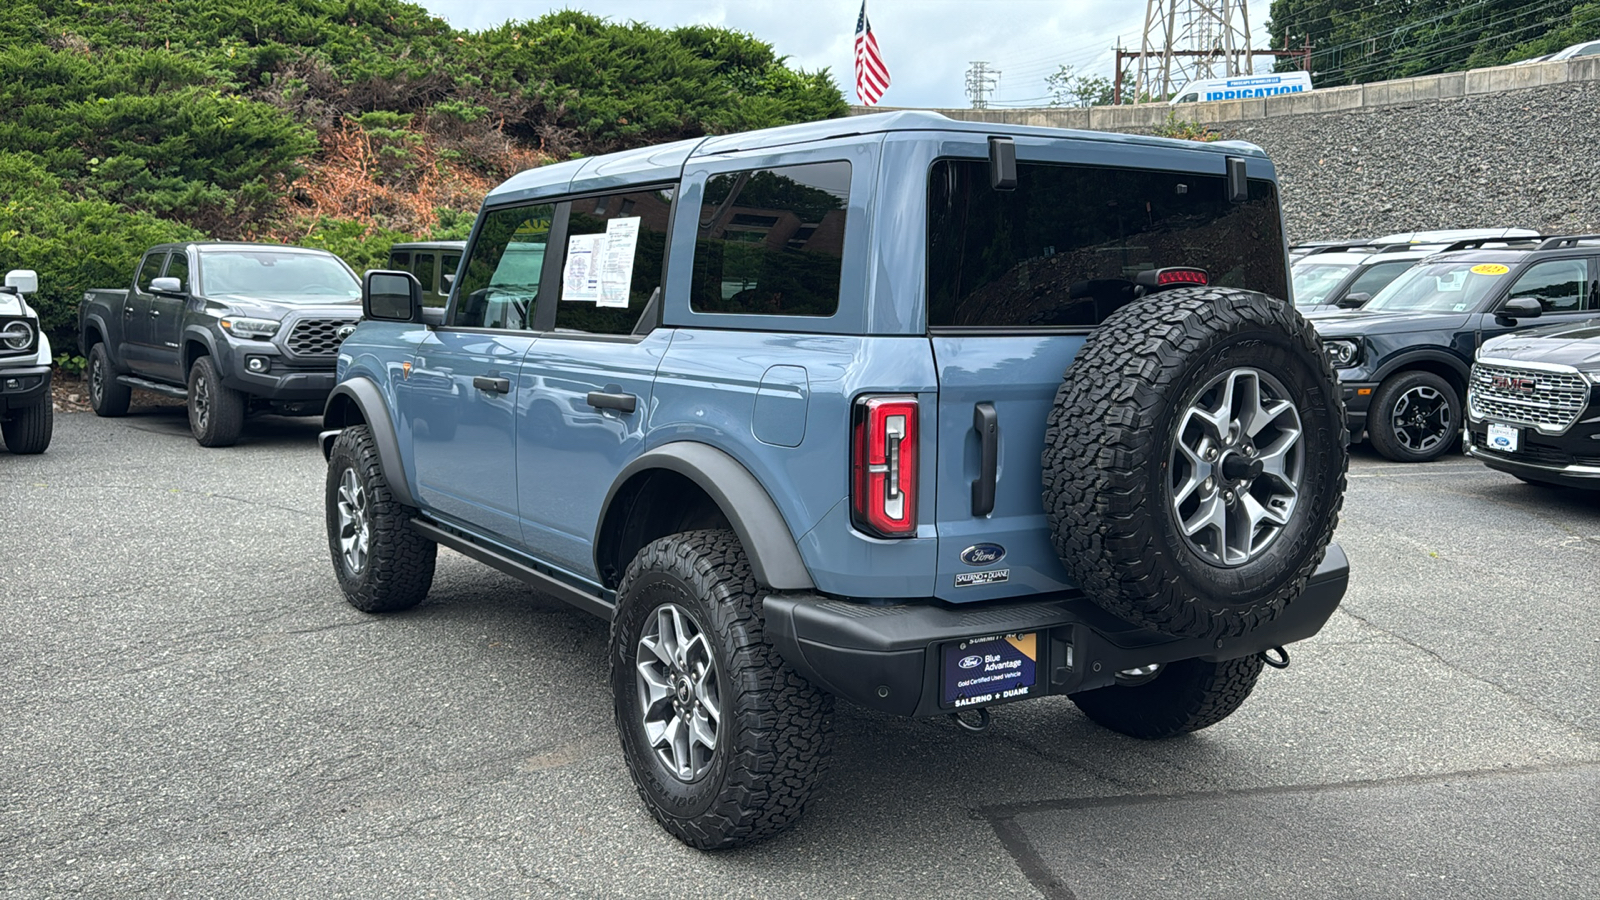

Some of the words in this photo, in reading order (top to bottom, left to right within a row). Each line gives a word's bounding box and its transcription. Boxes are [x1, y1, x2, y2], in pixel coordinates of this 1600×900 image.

[1206, 85, 1303, 101] IRRIGATION
[1492, 375, 1533, 392] GMC
[971, 549, 997, 562] Ford
[957, 573, 984, 583] SALERNO
[988, 570, 1008, 579] DUANE
[984, 654, 1001, 663] Blue
[984, 659, 1022, 672] Advantage
[957, 680, 970, 688] Gold
[970, 675, 991, 685] Certified
[991, 674, 1004, 682] Used
[1004, 671, 1022, 679] Vehicle
[955, 693, 993, 707] SALERNO
[1003, 687, 1029, 698] DUANE
